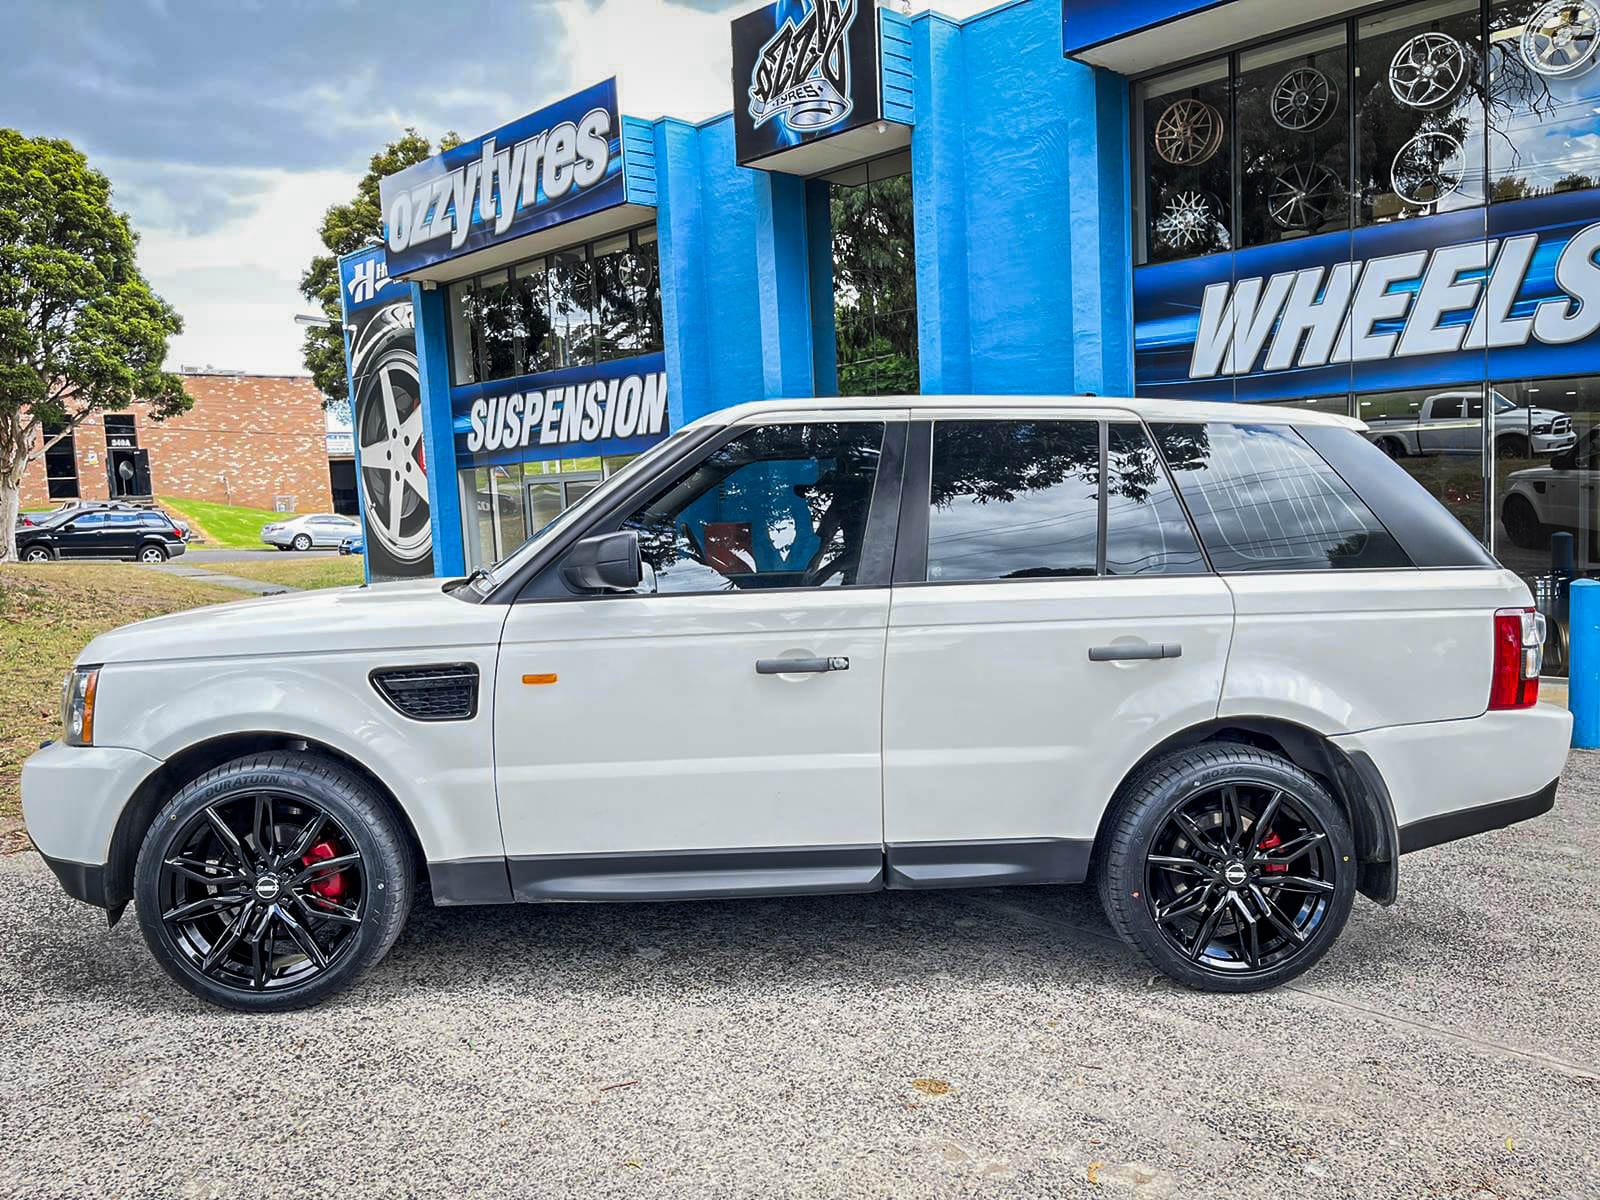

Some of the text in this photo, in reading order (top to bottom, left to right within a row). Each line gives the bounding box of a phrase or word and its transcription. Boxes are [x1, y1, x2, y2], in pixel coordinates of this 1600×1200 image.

[775, 84, 820, 106] TYRES
[1188, 223, 1600, 379] WHEELS
[467, 372, 668, 452] SUSPENSION
[205, 775, 281, 798] DURATURN
